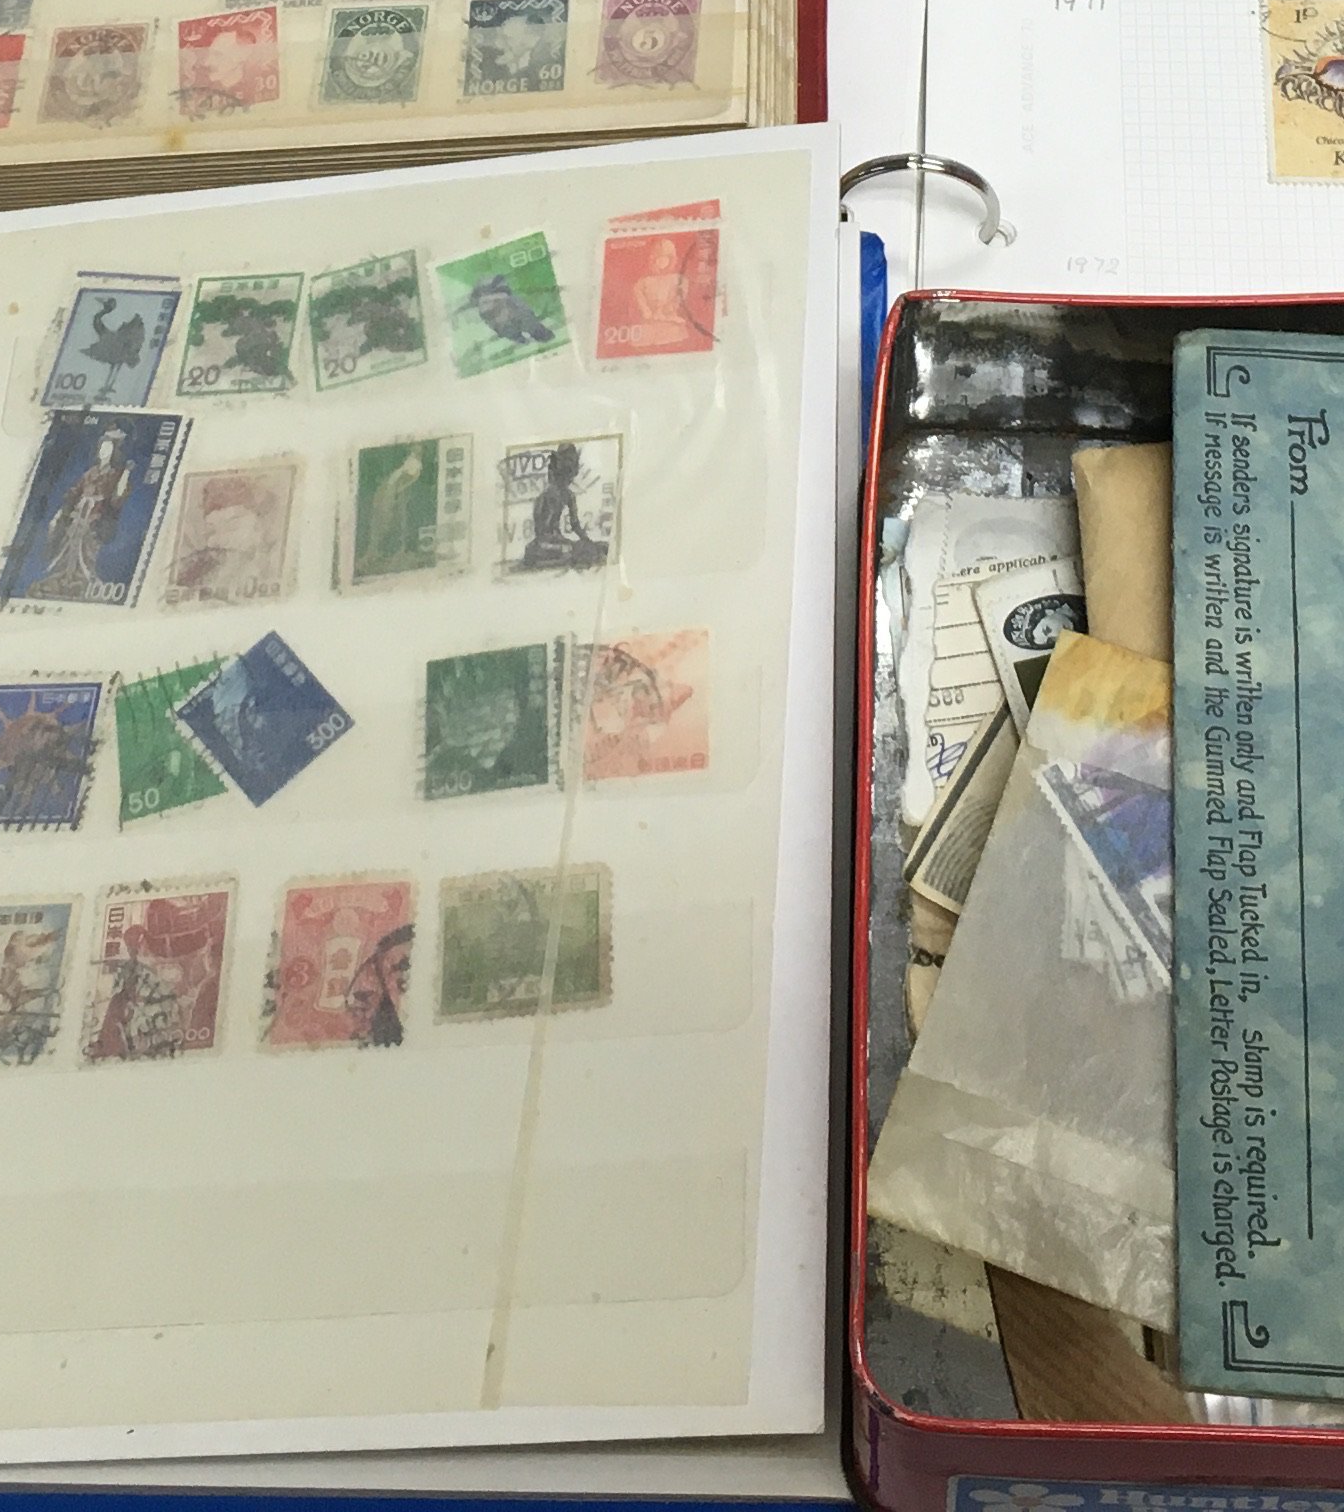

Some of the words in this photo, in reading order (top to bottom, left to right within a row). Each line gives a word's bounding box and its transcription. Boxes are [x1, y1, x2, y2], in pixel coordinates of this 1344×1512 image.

[347, 9, 409, 34] NORGE
[188, 365, 220, 387] 20
[1204, 412, 1228, 429] If
[1232, 412, 1257, 432] If
[1287, 409, 1331, 496] From
[1197, 433, 1223, 519] message
[1203, 523, 1222, 544] is
[1204, 553, 1229, 631] written
[1229, 523, 1260, 629] signature
[1205, 638, 1229, 676] and
[1235, 628, 1259, 645] is
[1205, 683, 1230, 718] the
[1235, 650, 1262, 725] written
[306, 713, 346, 752] 300
[1230, 729, 1263, 773] only
[1204, 725, 1230, 825] Gummed
[127, 790, 160, 813] 50
[1238, 778, 1265, 820] and
[1200, 831, 1234, 882] Flap
[1238, 831, 1263, 876] Flap
[1207, 888, 1237, 975] Sealed,
[1240, 883, 1268, 964] Tucked
[1238, 968, 1271, 1002] in,
[1208, 973, 1234, 1050] Letter
[1199, 1057, 1238, 1145] Postage
[1244, 1108, 1277, 1128] is
[1213, 1148, 1233, 1174] is
[1242, 1135, 1282, 1260] required.
[1201, 1177, 1246, 1287] charged.
